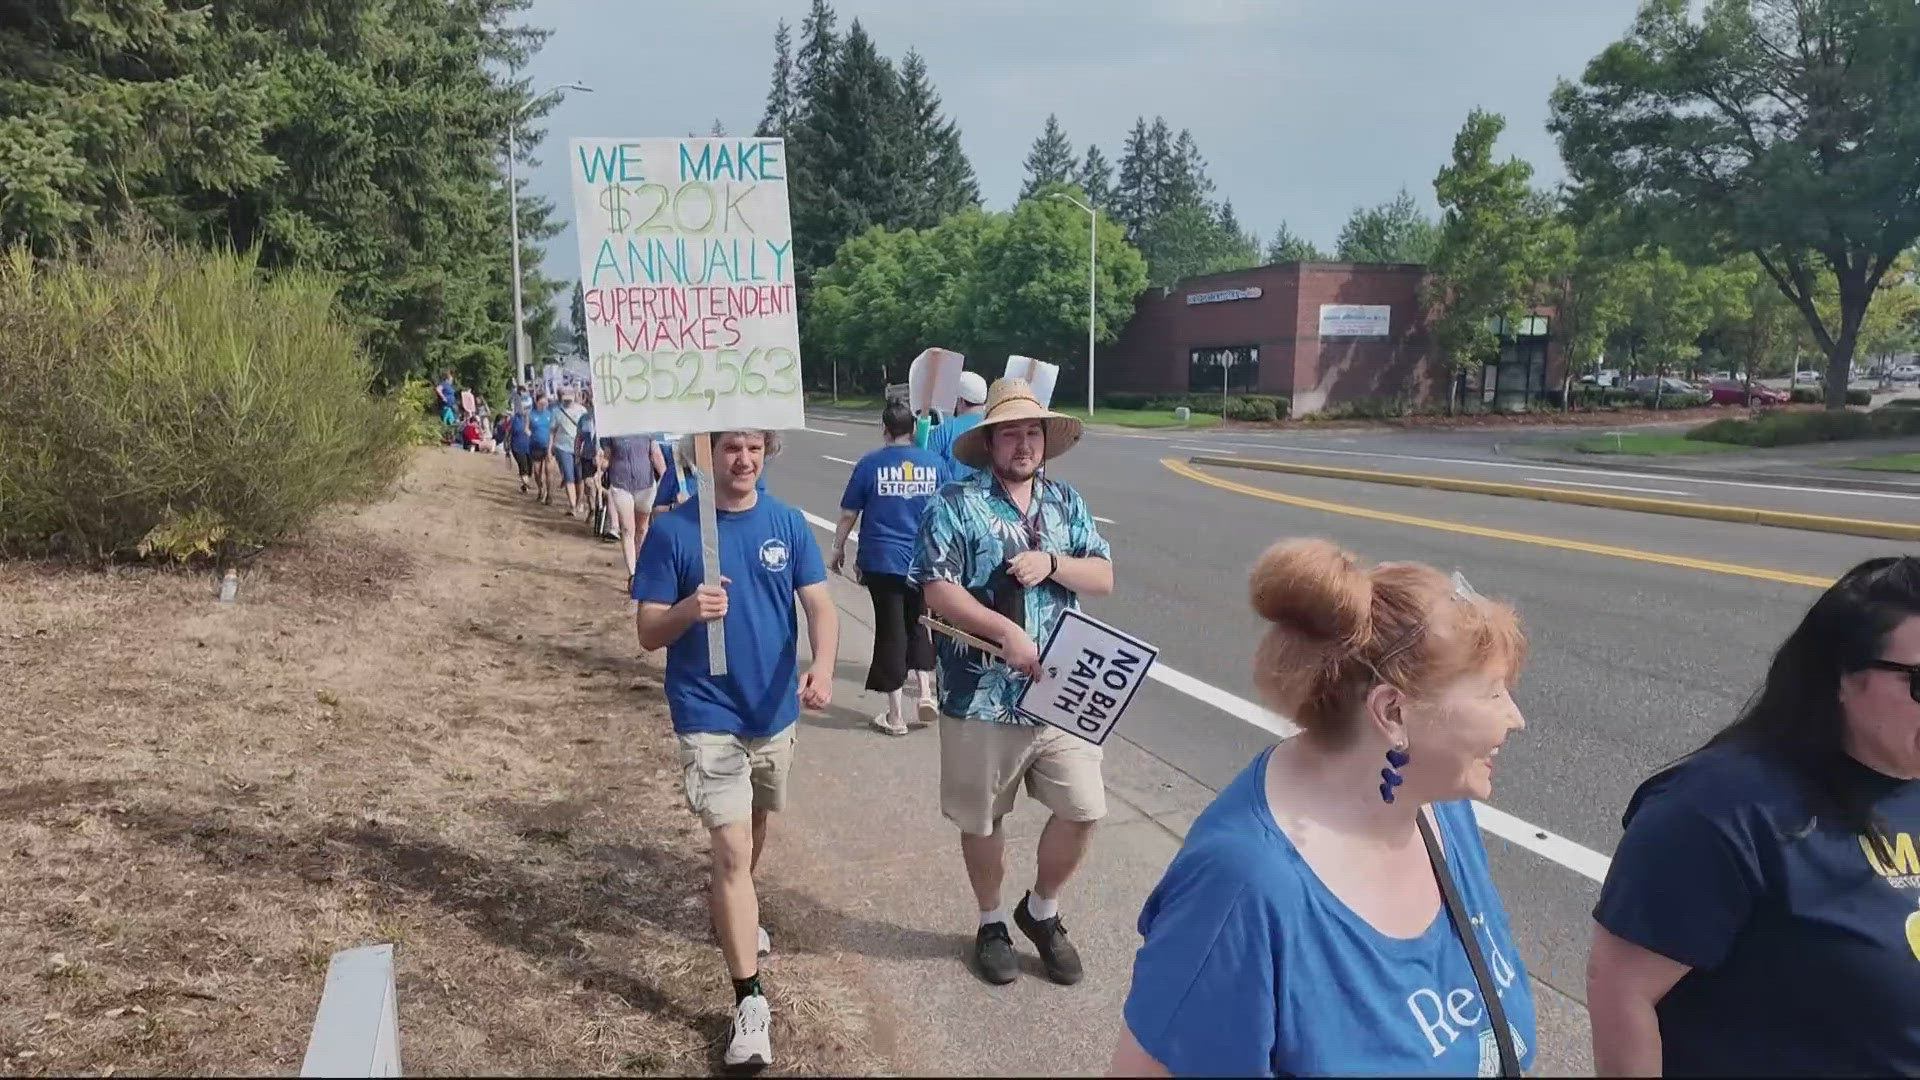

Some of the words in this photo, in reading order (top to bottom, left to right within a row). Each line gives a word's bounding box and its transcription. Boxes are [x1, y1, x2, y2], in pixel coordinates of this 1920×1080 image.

[579, 144, 644, 184] WE
[680, 142, 784, 182] MAKE
[599, 182, 756, 234] $20K
[593, 238, 791, 285] ANNUALLY
[585, 286, 794, 325] SUPERINTENDENT
[615, 316, 741, 352] MAKES
[594, 348, 798, 411] $352,563
[877, 464, 937, 481] UNION
[880, 483, 936, 495] STRONG
[1053, 648, 1105, 714] FAITH
[1103, 648, 1140, 690] NO
[1077, 691, 1116, 732] BAD
[1407, 923, 1515, 1058] Red
